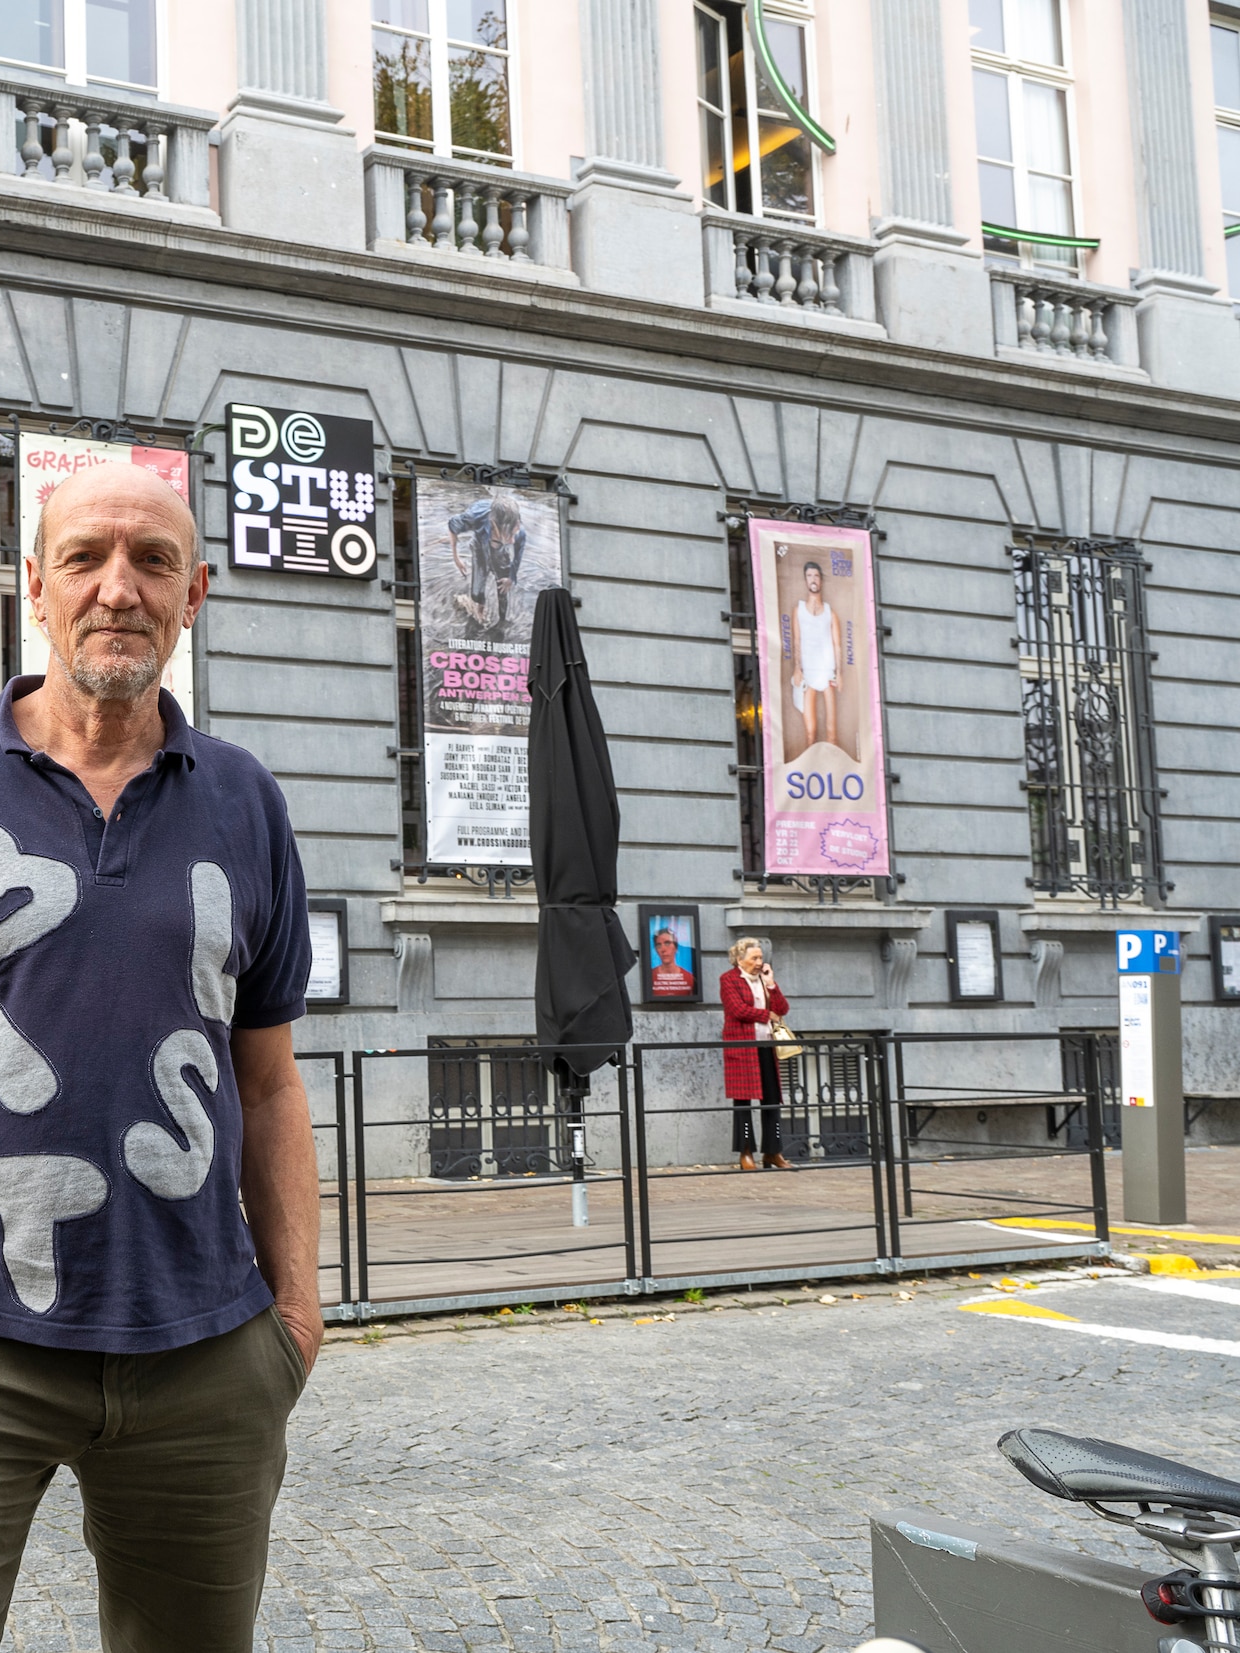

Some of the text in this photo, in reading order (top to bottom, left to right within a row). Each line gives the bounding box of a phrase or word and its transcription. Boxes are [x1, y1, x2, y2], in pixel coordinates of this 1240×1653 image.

[170, 467, 182, 477] 27
[448, 639, 487, 651] LITERATURE
[438, 688, 519, 701] ANTWERPEN
[786, 770, 864, 801] SOLO
[1118, 933, 1167, 970] P P
